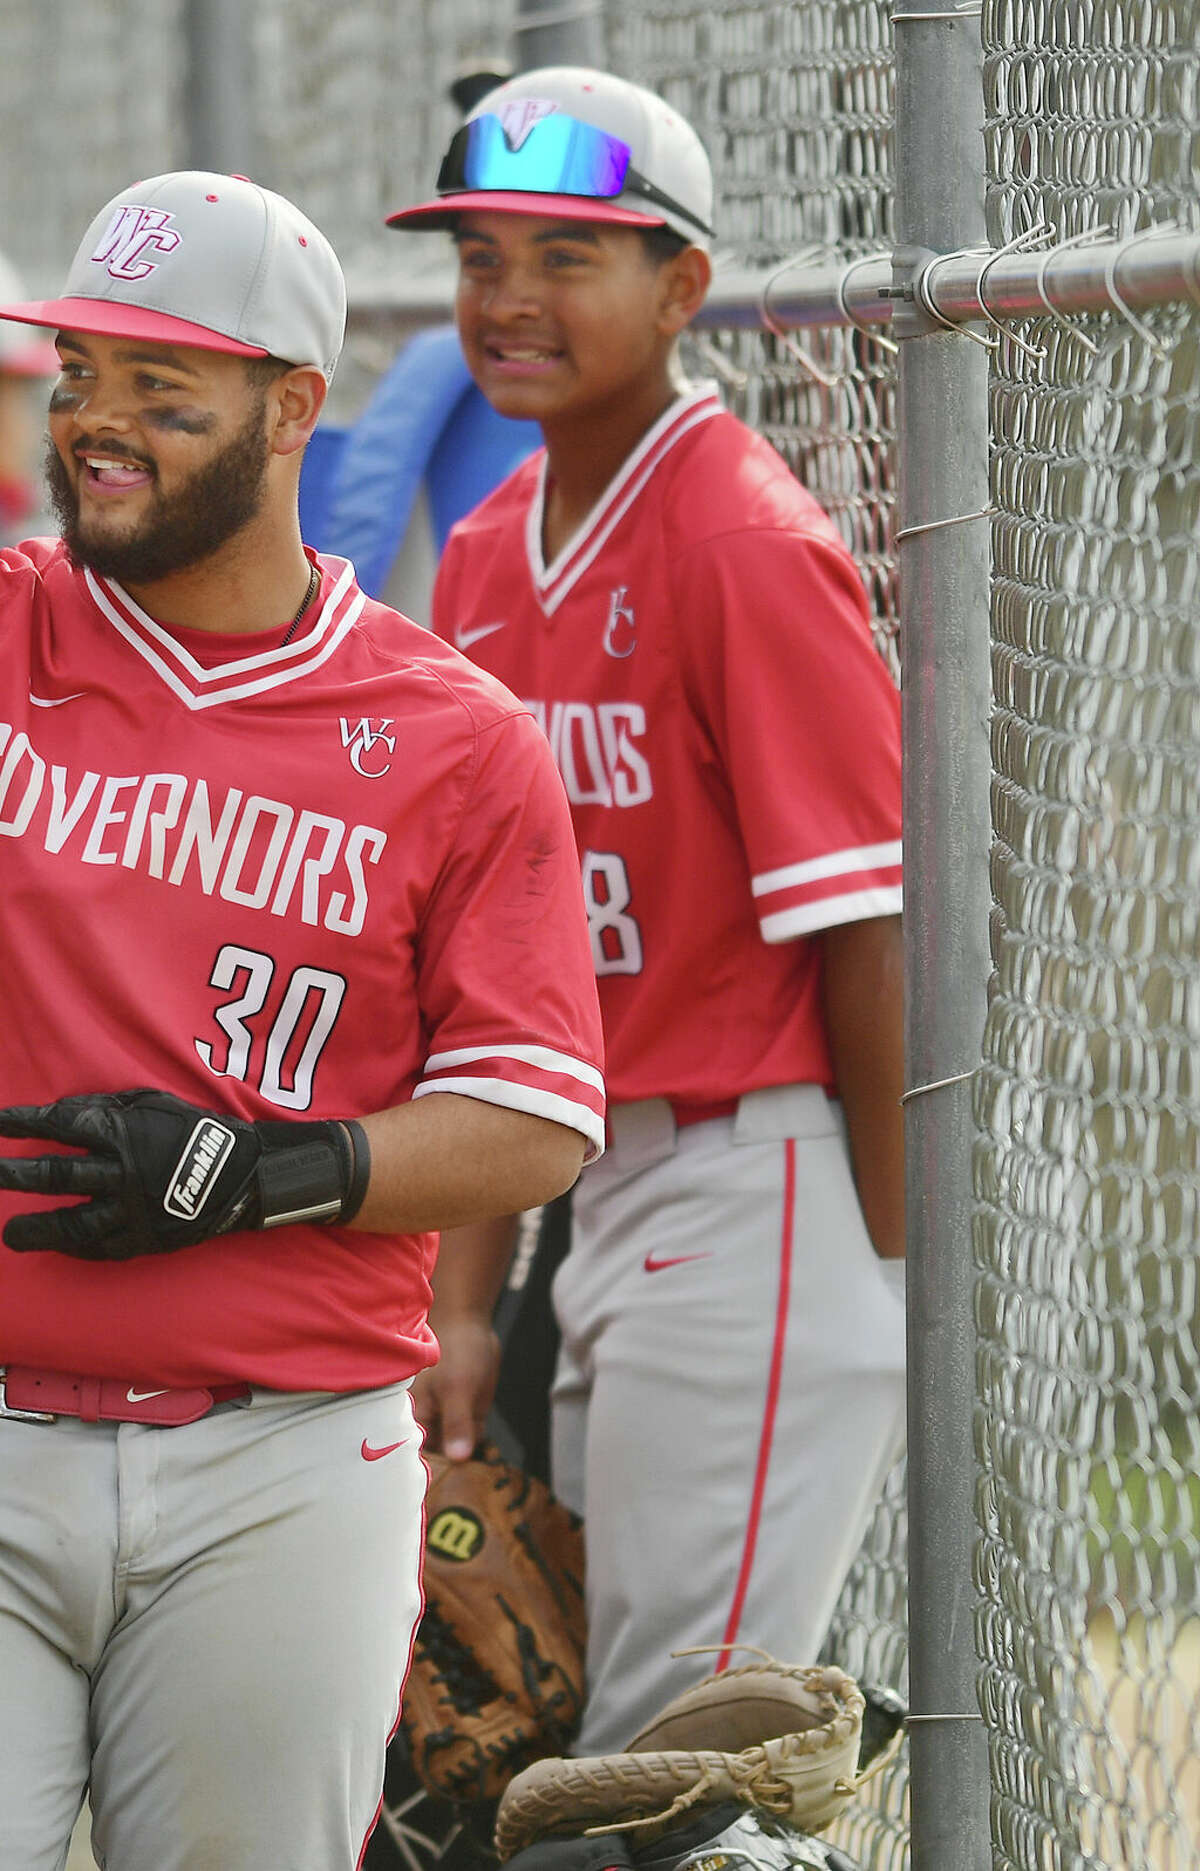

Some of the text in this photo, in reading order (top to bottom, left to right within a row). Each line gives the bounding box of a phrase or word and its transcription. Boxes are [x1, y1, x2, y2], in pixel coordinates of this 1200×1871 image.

[90, 205, 182, 282] WC
[339, 716, 397, 779] WC
[194, 944, 347, 1111] 30
